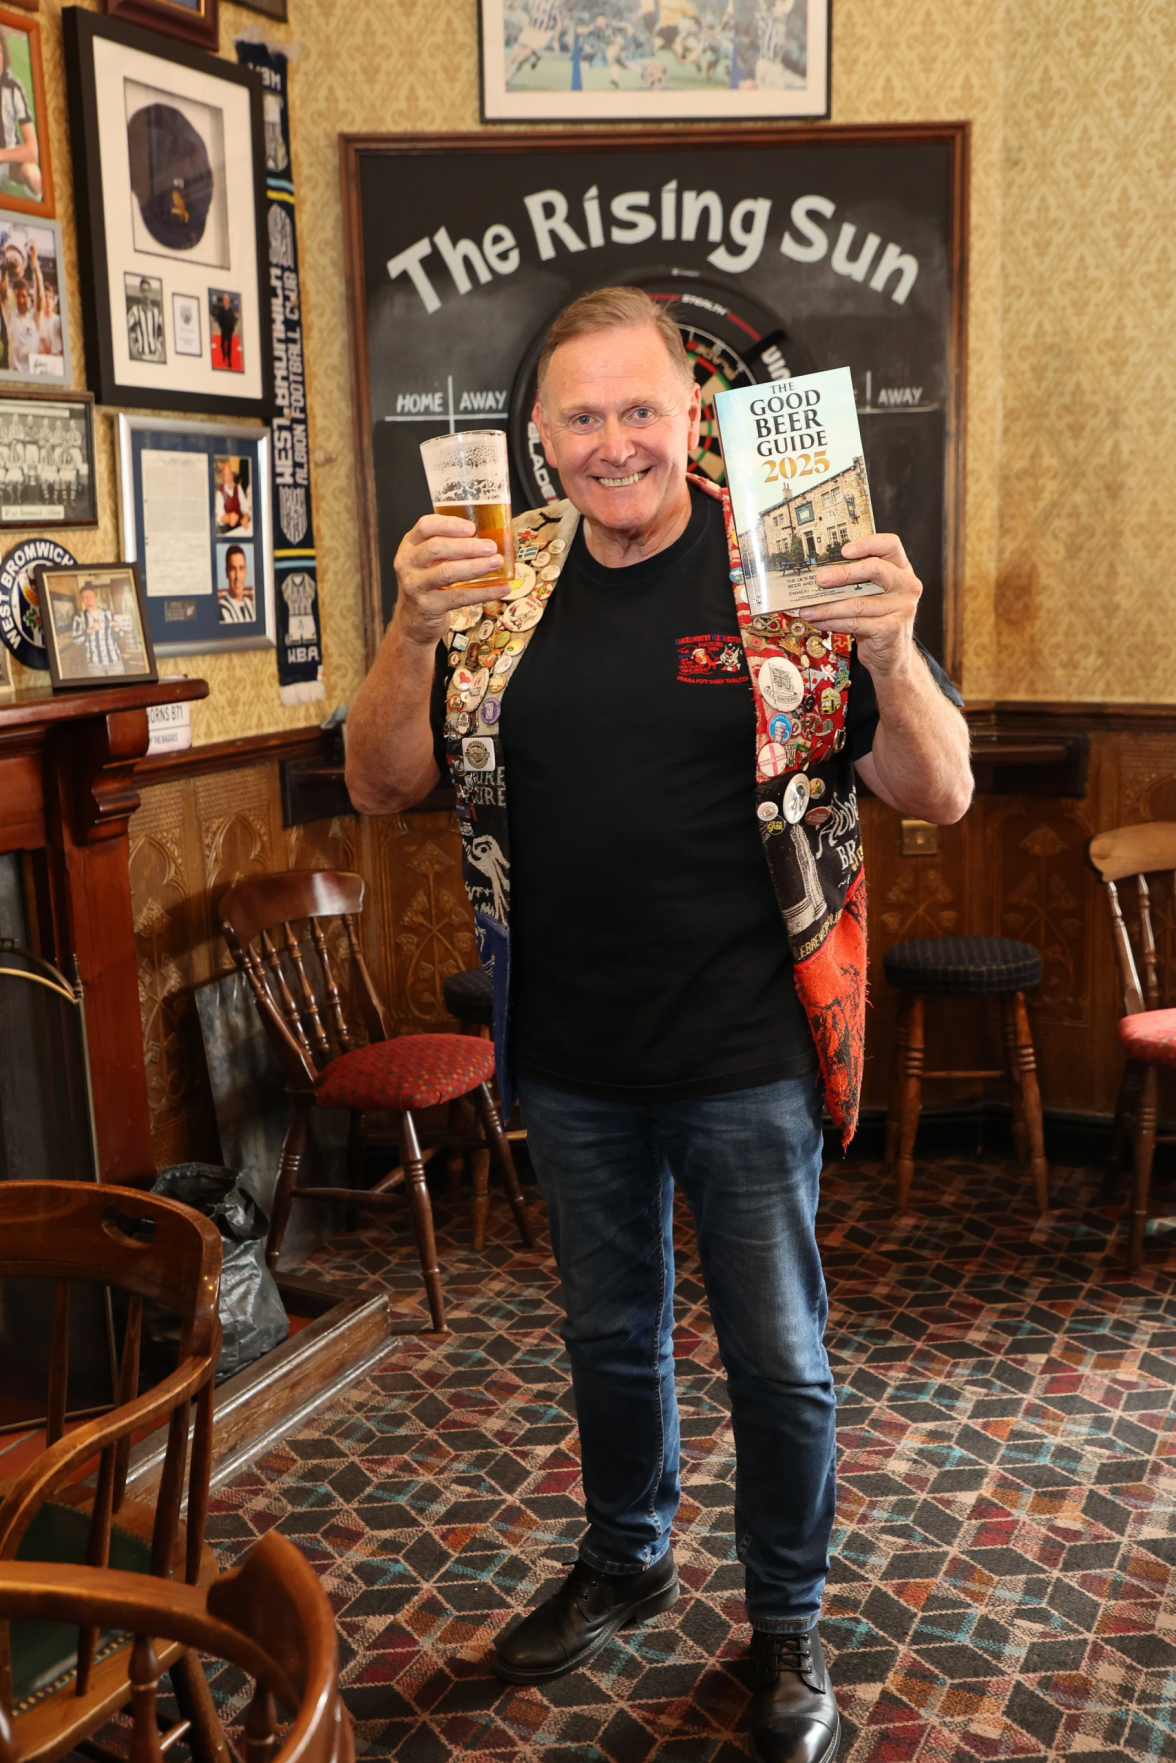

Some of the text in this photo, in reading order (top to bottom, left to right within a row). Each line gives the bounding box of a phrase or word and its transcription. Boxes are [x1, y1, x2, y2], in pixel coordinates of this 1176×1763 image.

[386, 179, 919, 315] The Rising Sun
[283, 270, 309, 486] ALBION FOOTBALL CLUB
[769, 381, 796, 395] THE
[396, 390, 507, 414] HOME AWAY
[749, 389, 822, 417] GOOD
[877, 386, 923, 406] AWAY
[753, 408, 825, 440] BEER
[272, 417, 294, 485] WEST
[756, 430, 829, 458] GUIDE
[527, 421, 558, 500] BLADE
[761, 449, 831, 484] 2025
[0, 591, 22, 650] WEST
[171, 705, 184, 721] B71
